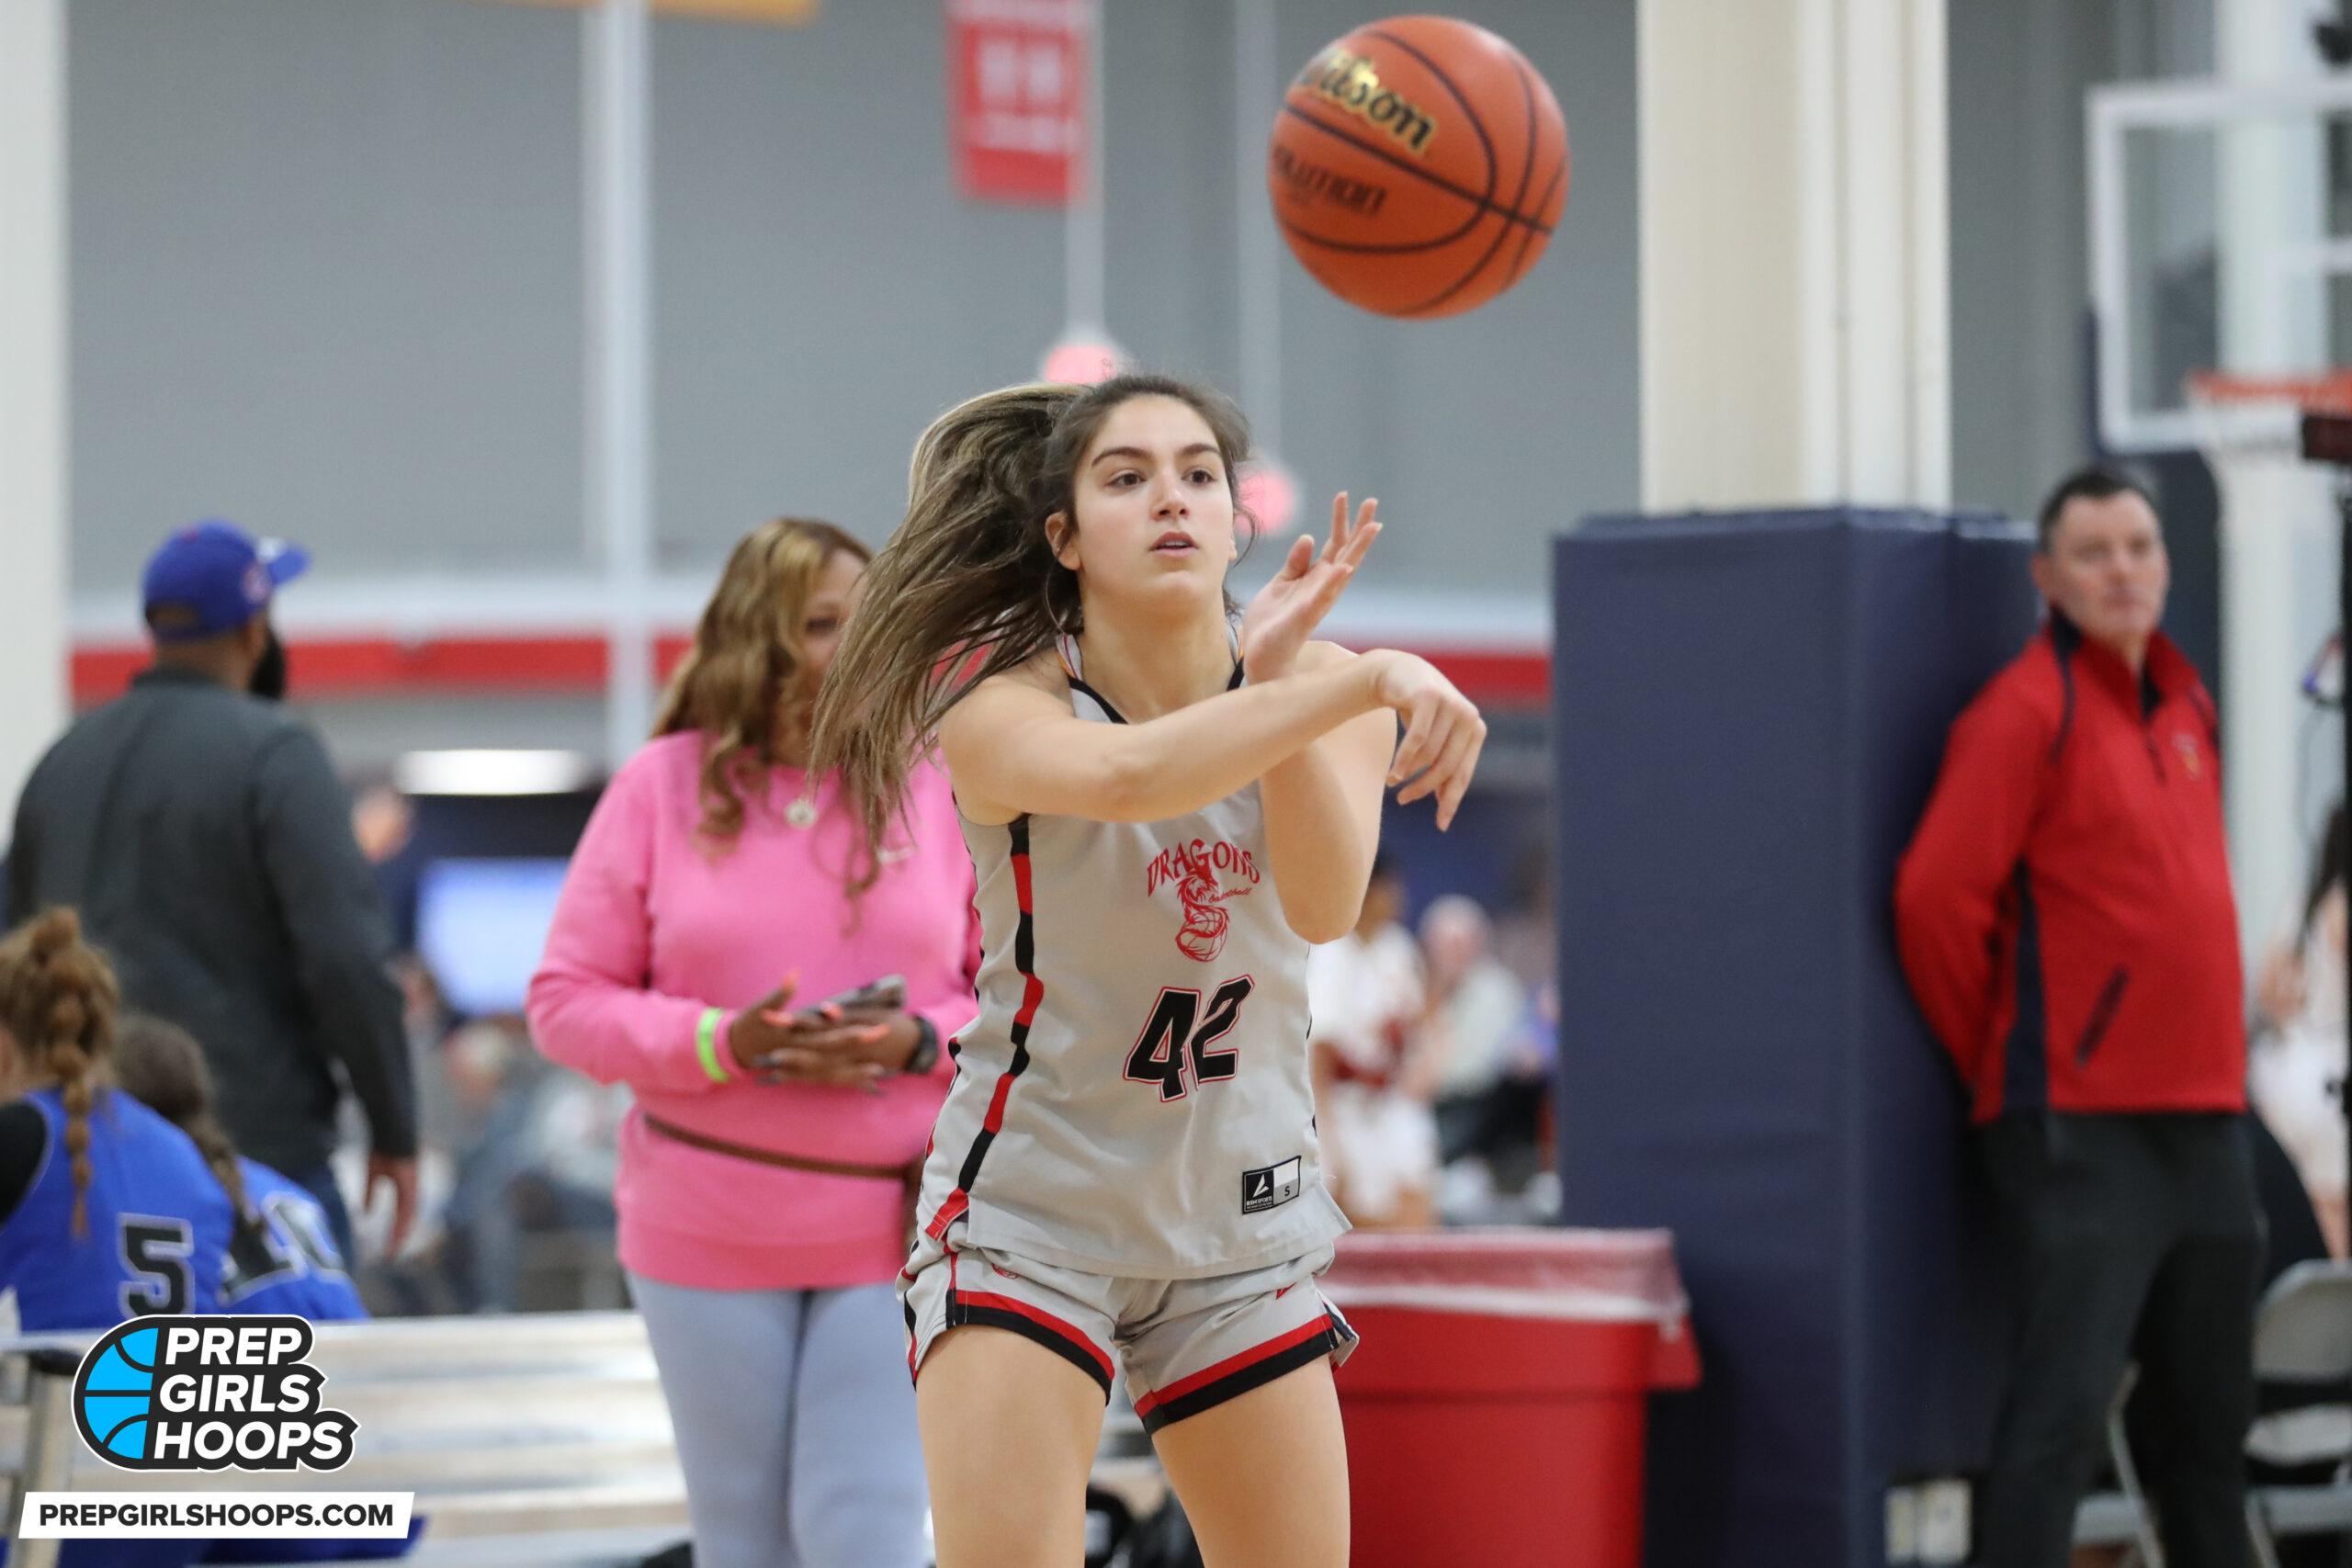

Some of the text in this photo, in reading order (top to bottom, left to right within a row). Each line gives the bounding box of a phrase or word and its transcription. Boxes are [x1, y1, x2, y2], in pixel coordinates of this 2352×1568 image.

[1147, 838, 1261, 897] DRAGONS
[1123, 974, 1255, 1102] 42
[117, 1212, 196, 1319] 5
